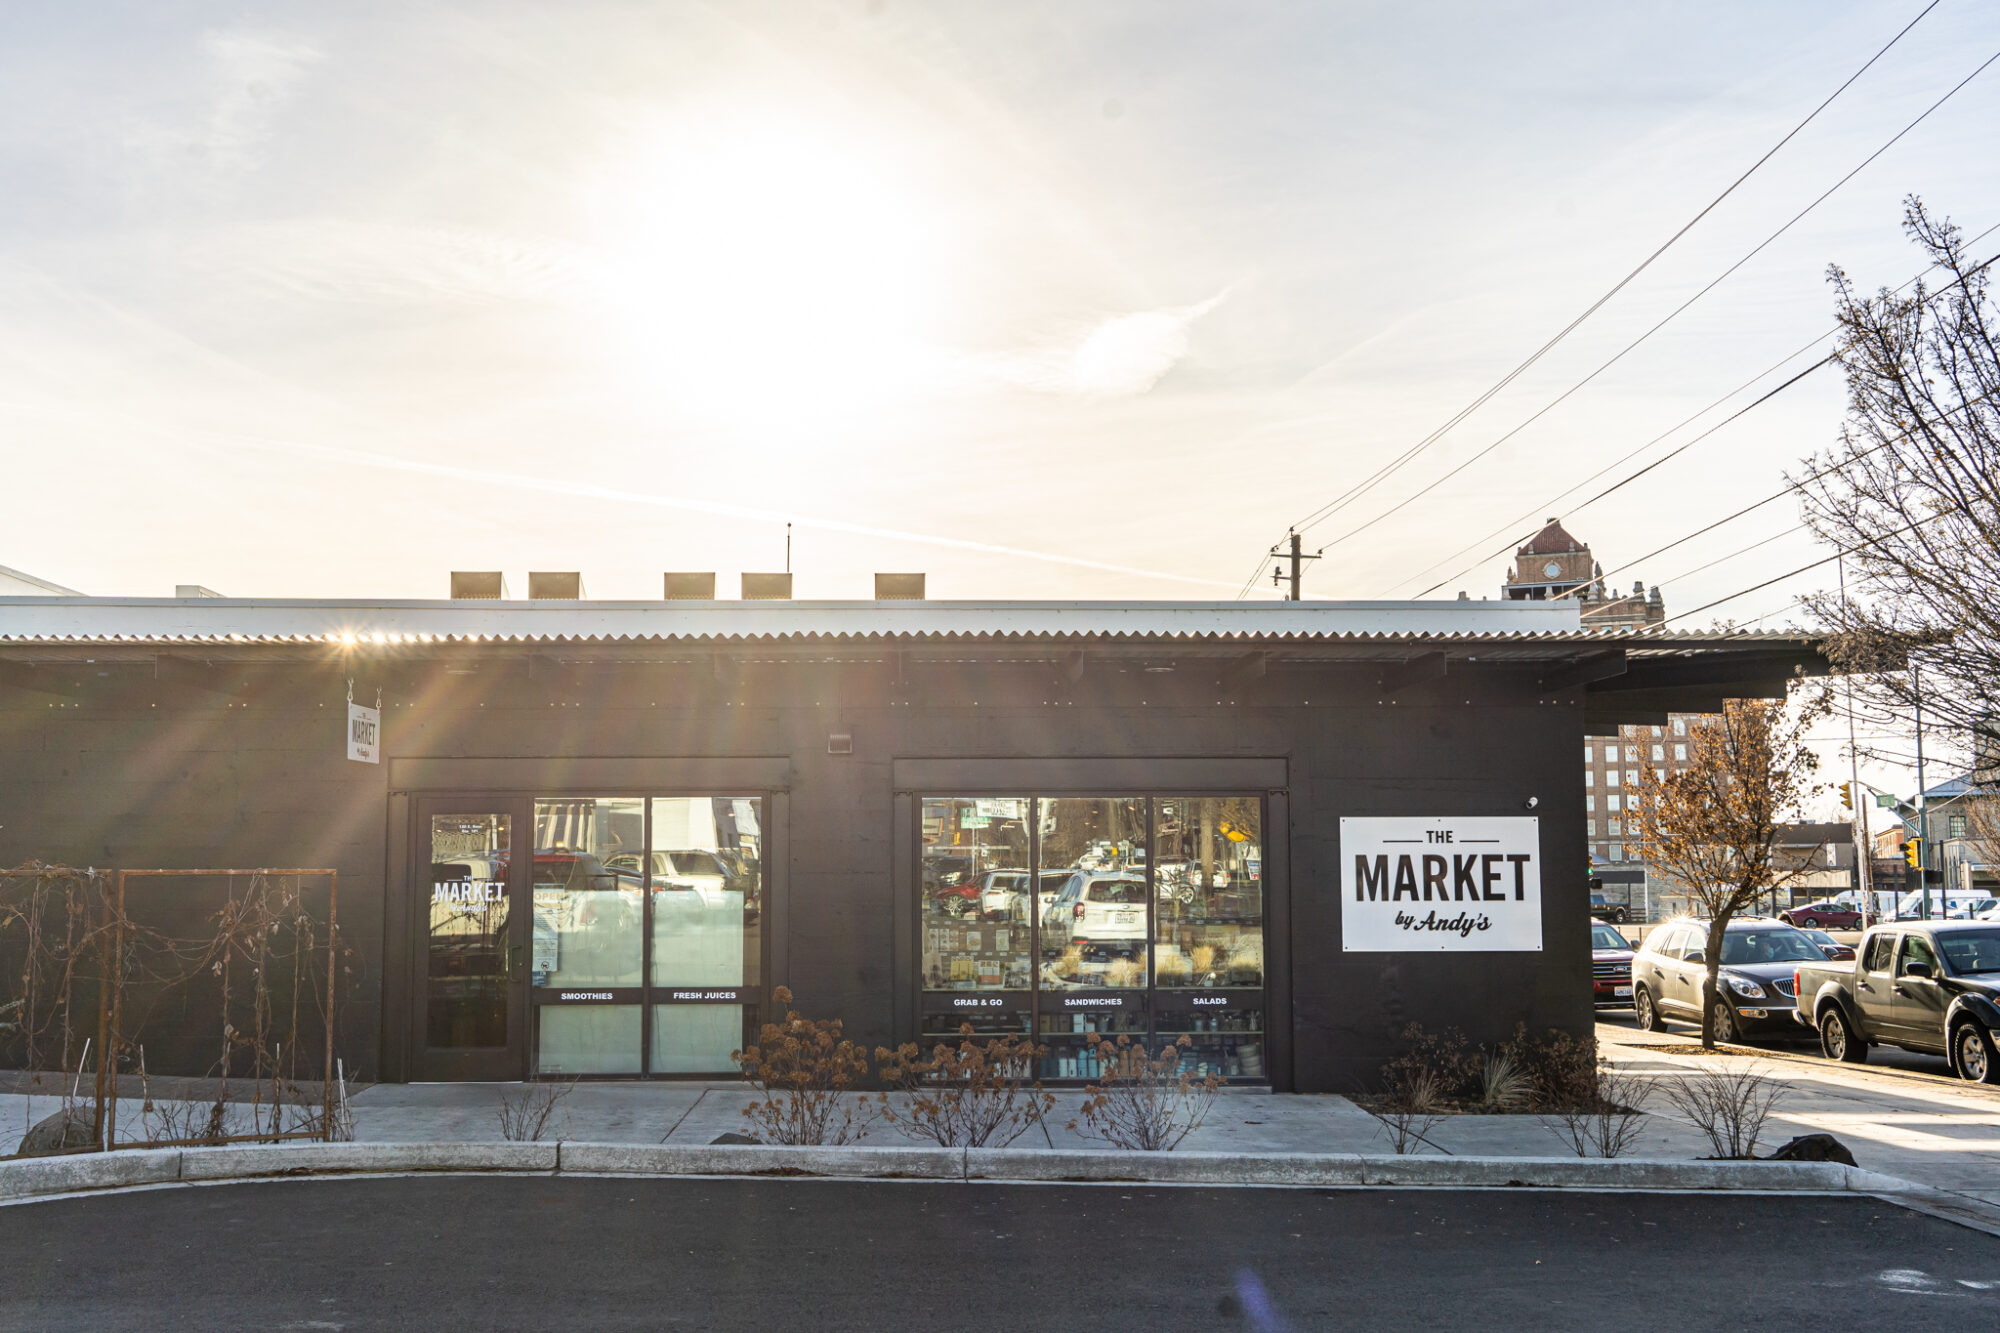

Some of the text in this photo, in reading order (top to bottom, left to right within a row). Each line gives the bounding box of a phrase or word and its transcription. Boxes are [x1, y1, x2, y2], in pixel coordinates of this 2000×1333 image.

[352, 719, 376, 746] MARKET
[1425, 830, 1454, 844] THE
[1354, 853, 1531, 902] MARKET
[434, 882, 505, 902] MARKET
[1394, 910, 1493, 938] by Andy's
[561, 992, 614, 1000] SMOOTHIES
[673, 991, 737, 1000] FRESH JUICES
[1064, 998, 1123, 1006] SANDWICHES
[1193, 997, 1228, 1005] SALADS
